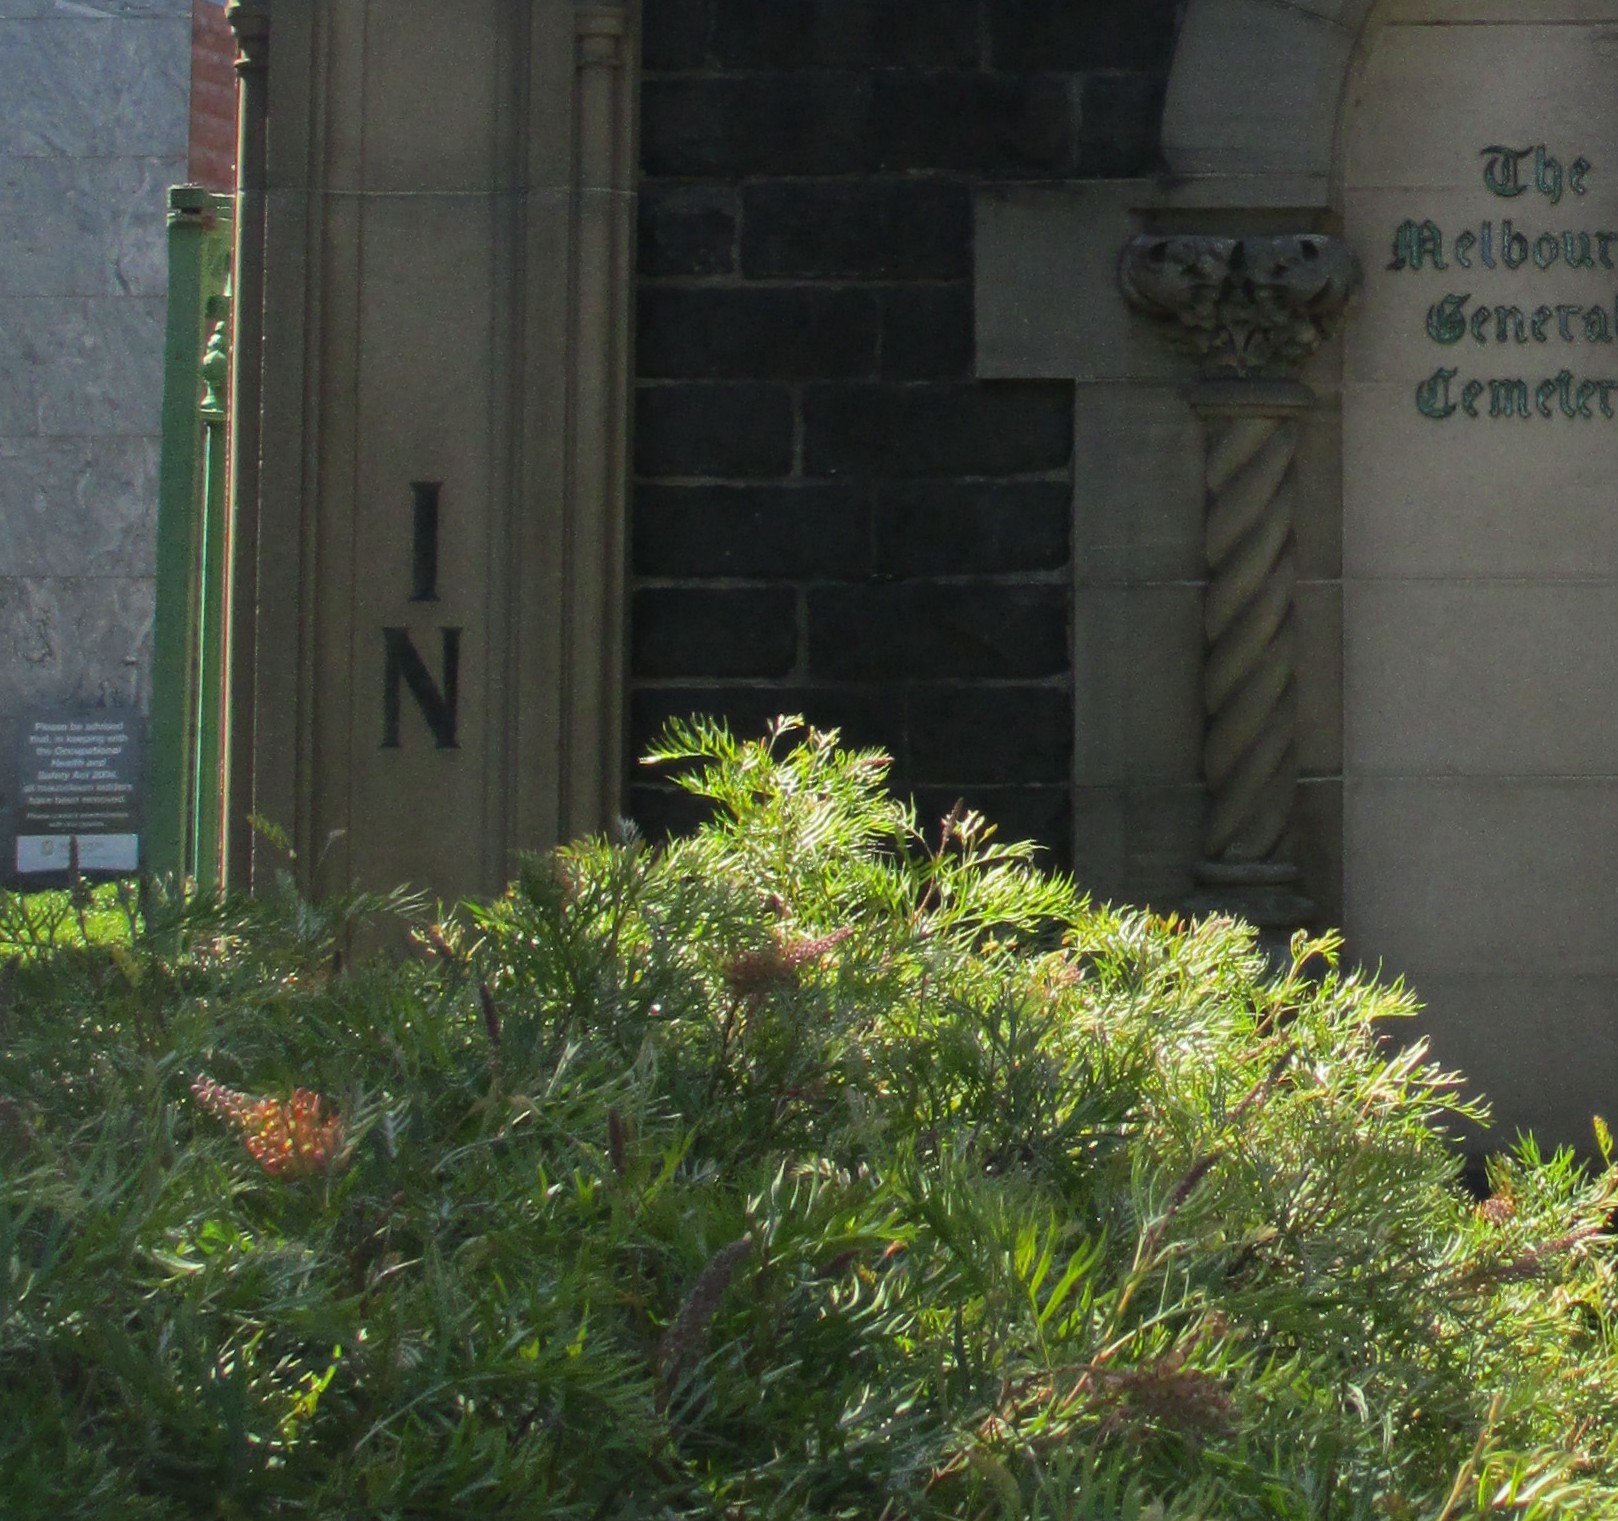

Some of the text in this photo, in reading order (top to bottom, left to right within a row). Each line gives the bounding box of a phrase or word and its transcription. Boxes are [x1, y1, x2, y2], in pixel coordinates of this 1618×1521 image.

[1480, 144, 1591, 204] The
[379, 481, 464, 750] IN
[34, 722, 124, 731] Please be advised
[66, 735, 105, 745] keeping
[107, 734, 129, 743] with
[36, 746, 122, 756] the Occupational
[51, 758, 107, 768] Health and
[37, 771, 71, 781] Safety
[72, 771, 90, 780] Act
[28, 797, 52, 805] have
[55, 796, 79, 805] been
